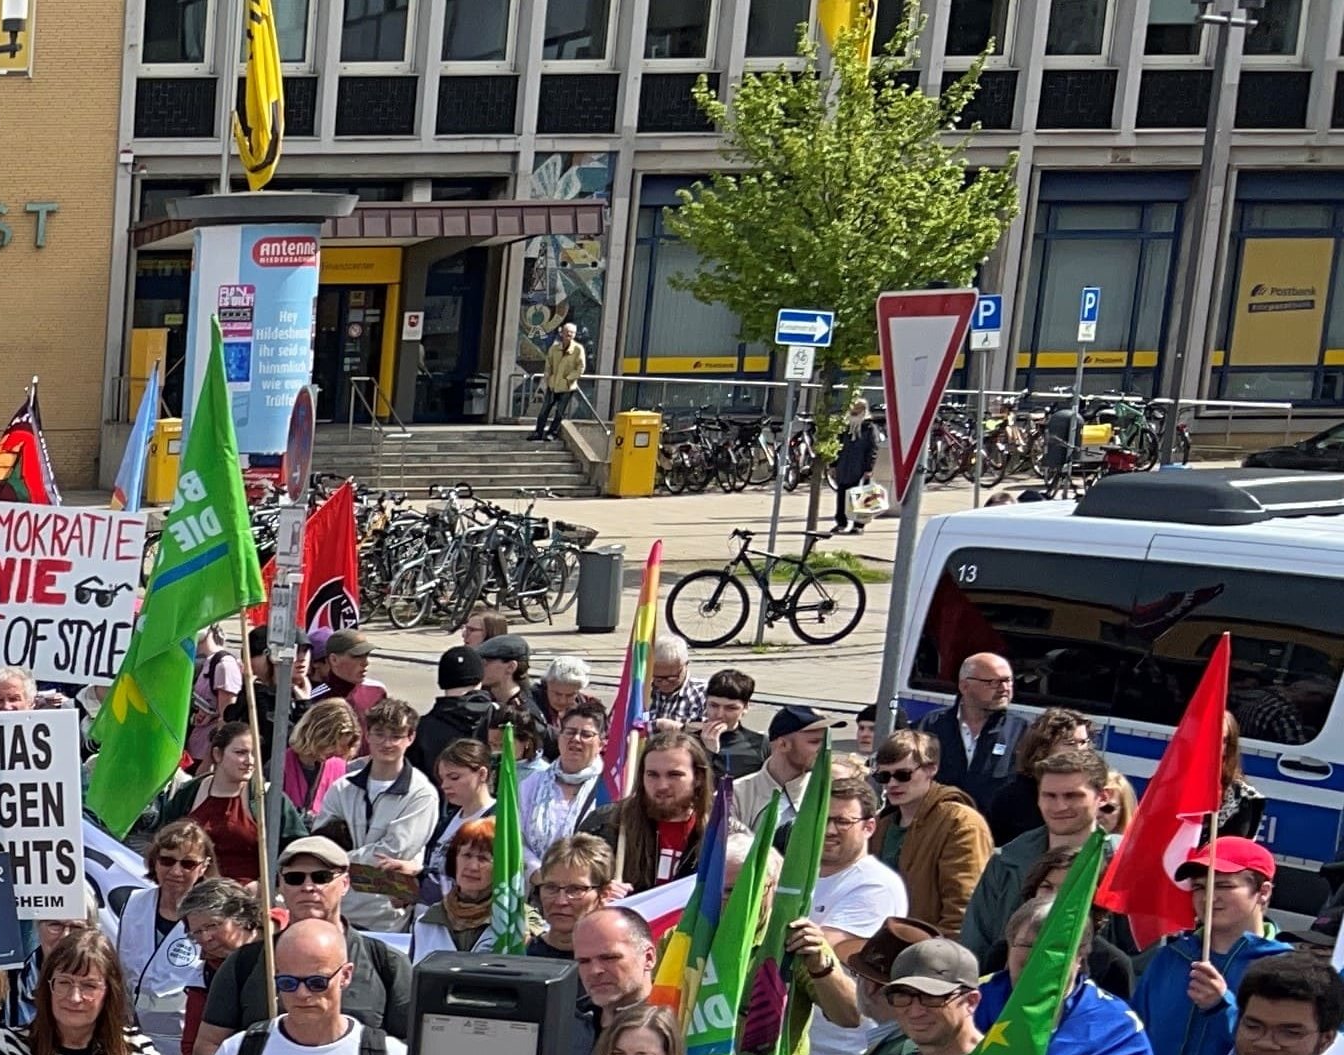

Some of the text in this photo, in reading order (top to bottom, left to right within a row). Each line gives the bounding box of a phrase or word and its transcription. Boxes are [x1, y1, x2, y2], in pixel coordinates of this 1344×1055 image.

[978, 300, 996, 326] P
[1085, 293, 1096, 318] P
[279, 311, 298, 326] Hey
[958, 564, 978, 583] 13
[3, 616, 54, 670] OF
[53, 618, 134, 680] STYLE
[15, 896, 64, 908] SHEIM
